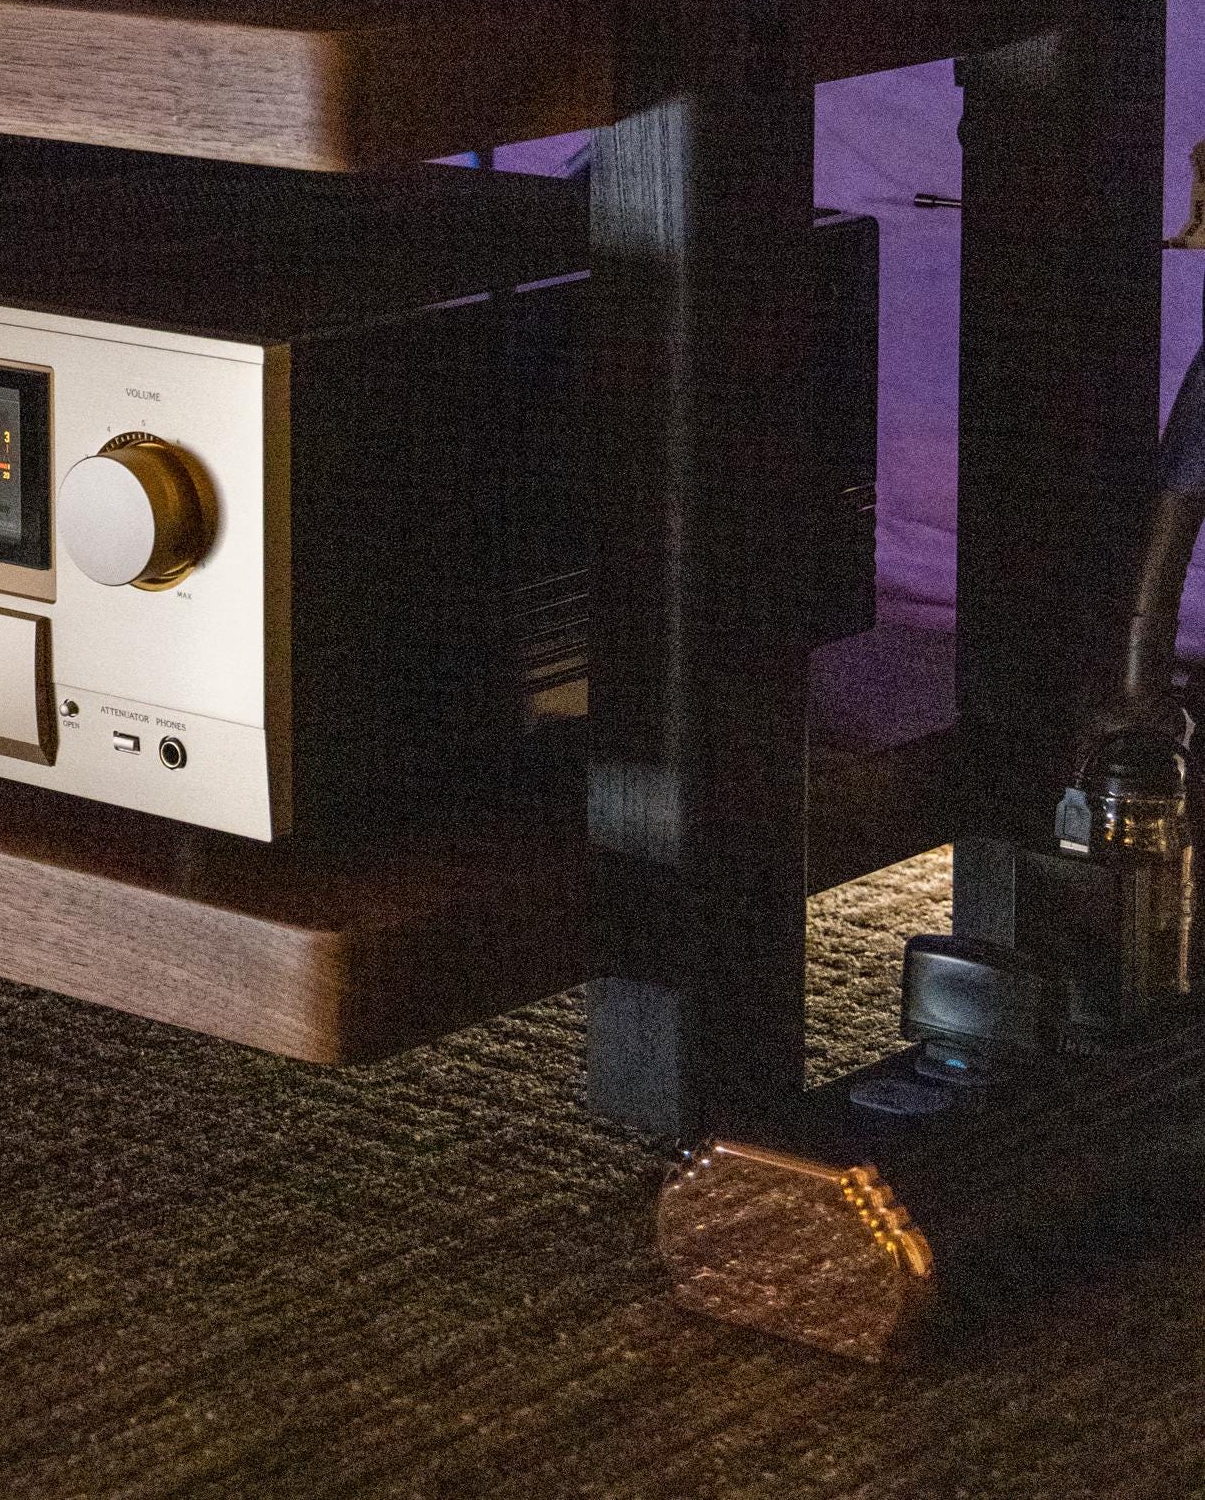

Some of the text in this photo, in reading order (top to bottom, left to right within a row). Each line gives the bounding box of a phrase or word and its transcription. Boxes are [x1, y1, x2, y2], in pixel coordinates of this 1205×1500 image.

[126, 387, 161, 402] VOLUME
[4, 431, 10, 443] 3
[176, 591, 193, 600] MAX
[100, 705, 187, 731] ATTENUATOR PHONES
[62, 720, 80, 730] OPEN
